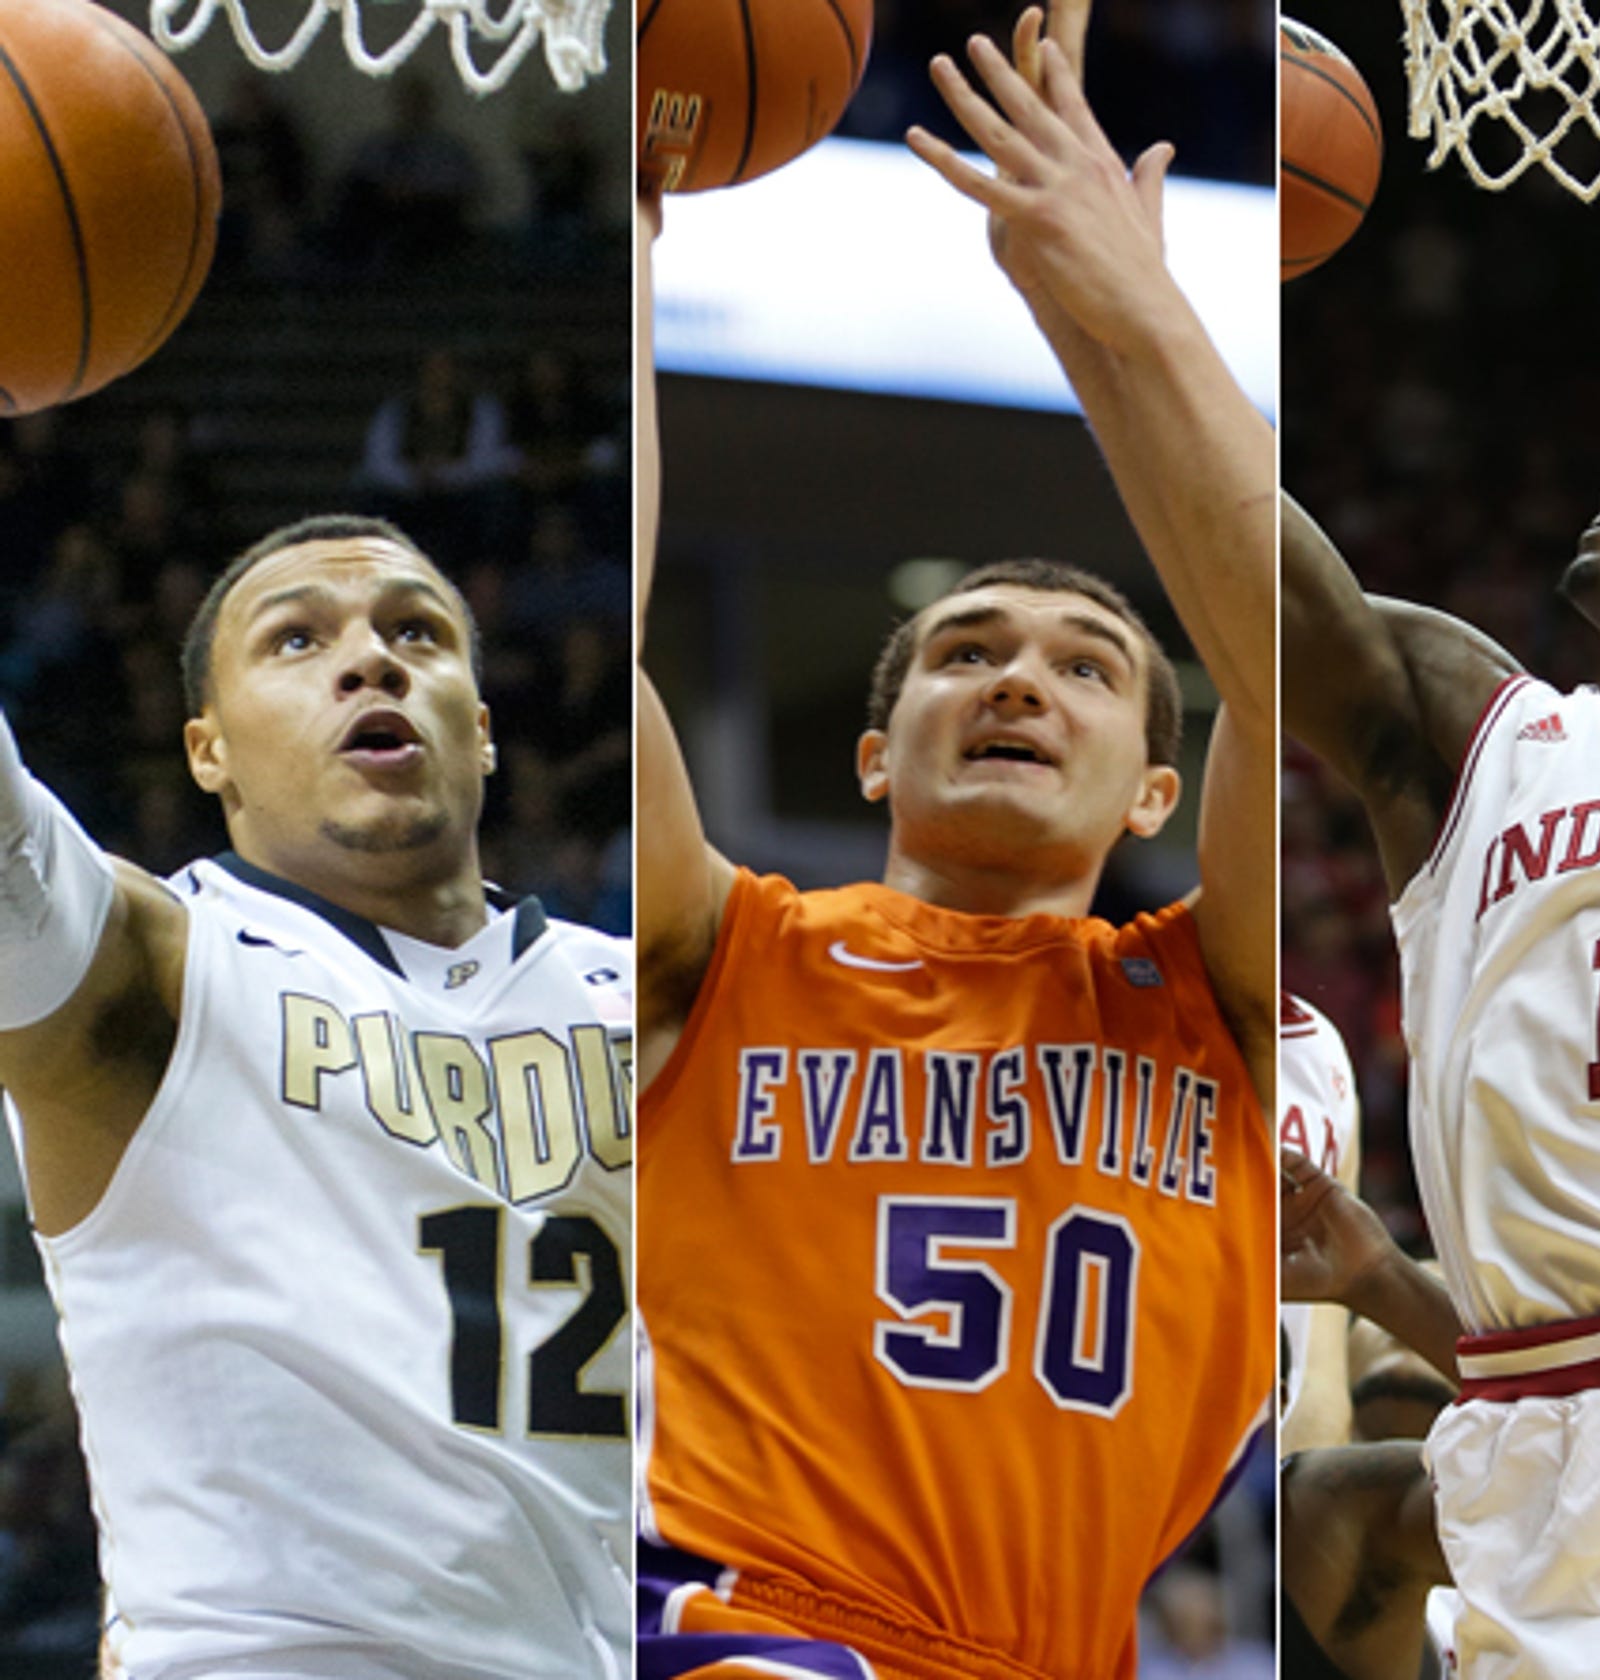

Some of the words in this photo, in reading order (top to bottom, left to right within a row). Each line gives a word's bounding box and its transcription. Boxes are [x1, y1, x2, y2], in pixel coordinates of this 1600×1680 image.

[730, 1043, 1218, 1206] EVANSVILLE
[416, 1204, 632, 1442] 12
[873, 1195, 1141, 1420] 50
